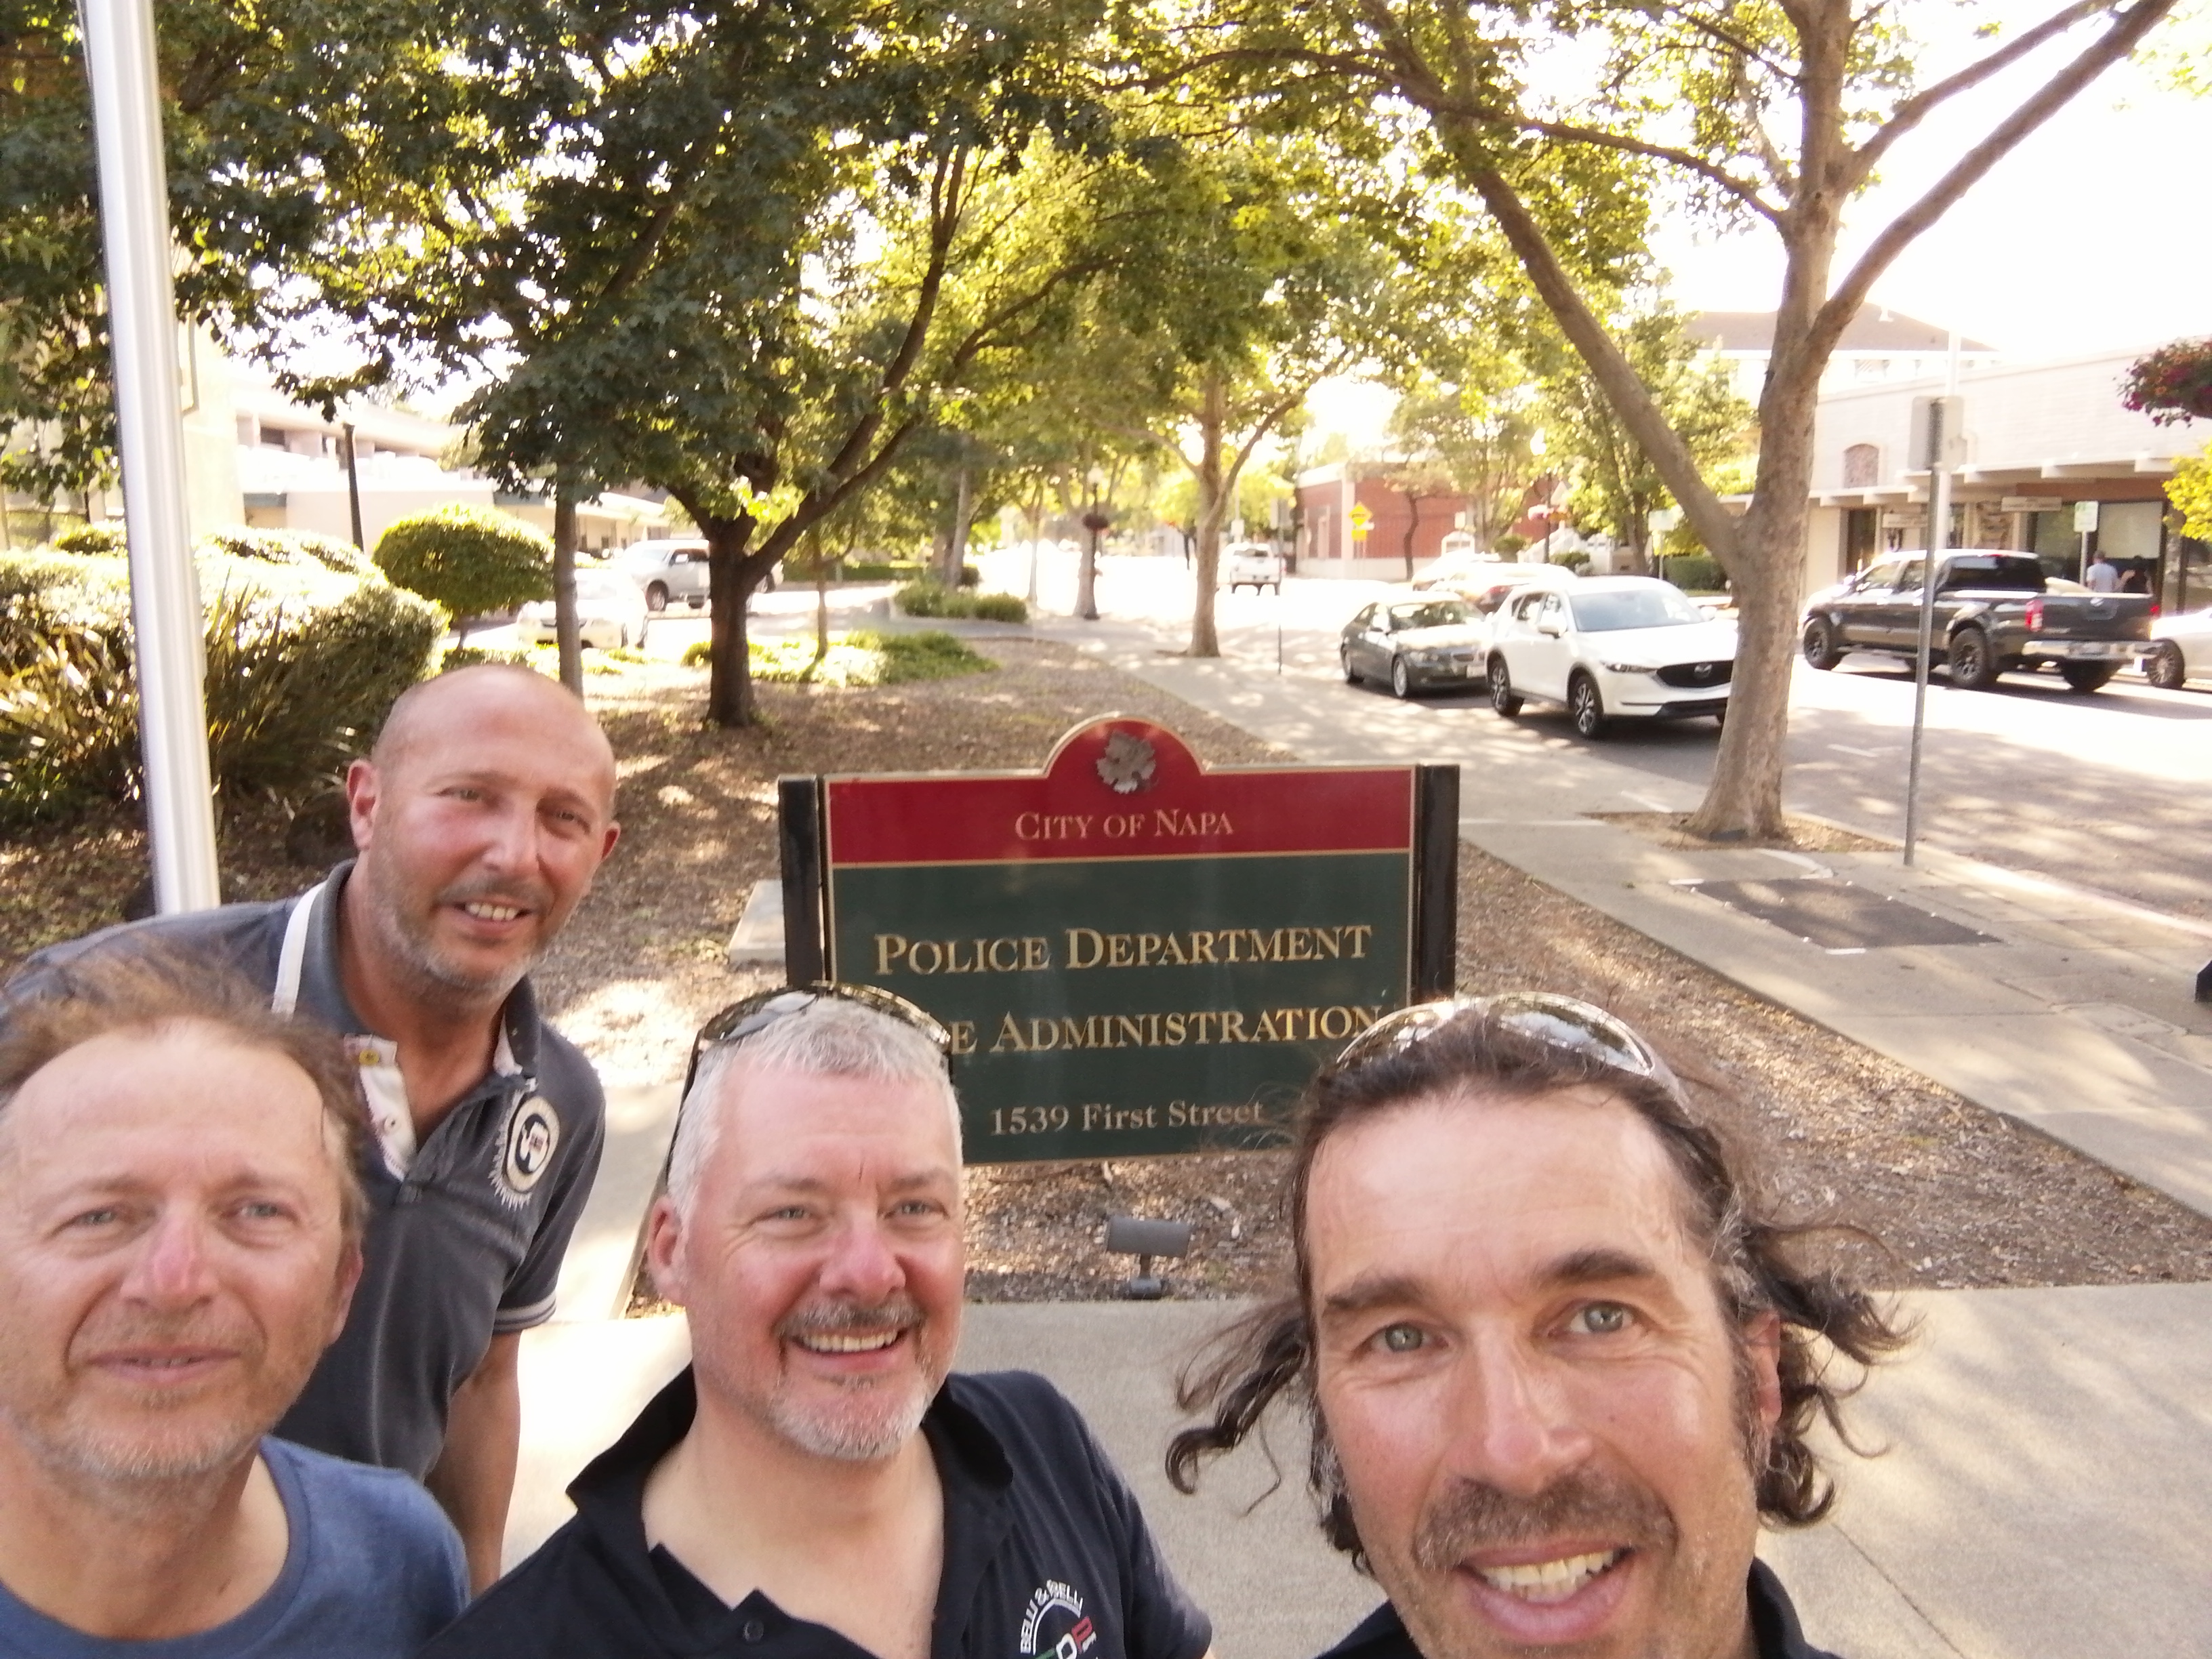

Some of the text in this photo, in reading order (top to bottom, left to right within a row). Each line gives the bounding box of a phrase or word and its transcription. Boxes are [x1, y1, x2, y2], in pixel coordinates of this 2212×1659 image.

[1015, 808, 1234, 840] CITY OF NAPA
[874, 924, 1372, 976] POLICE DEPARTMENT
[989, 1004, 1383, 1053] ADMINISTRATION
[991, 1099, 1265, 1136] 1539 First Street
